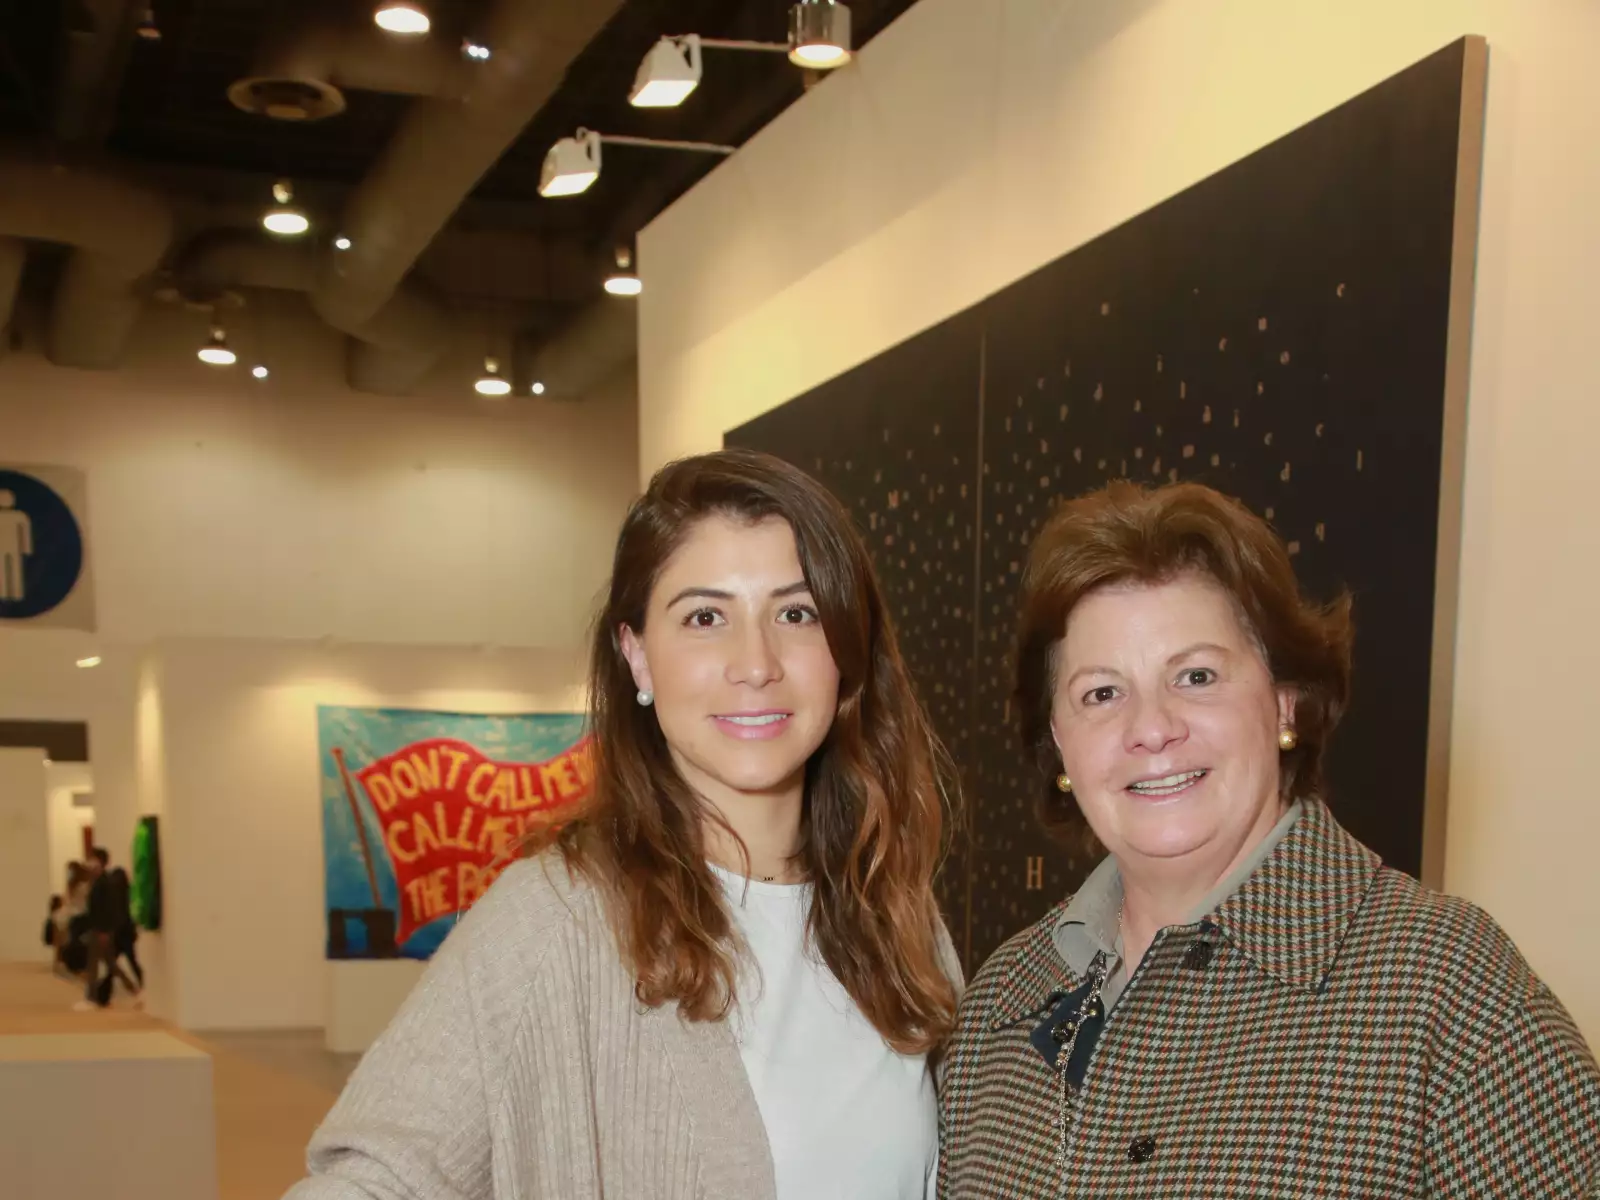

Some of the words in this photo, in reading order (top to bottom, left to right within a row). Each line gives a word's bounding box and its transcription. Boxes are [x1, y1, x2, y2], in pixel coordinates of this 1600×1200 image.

[466, 762, 542, 810] CALL
[539, 757, 581, 804] ME
[388, 801, 475, 863] CALL
[404, 866, 452, 922] THE
[1026, 855, 1044, 890] H
